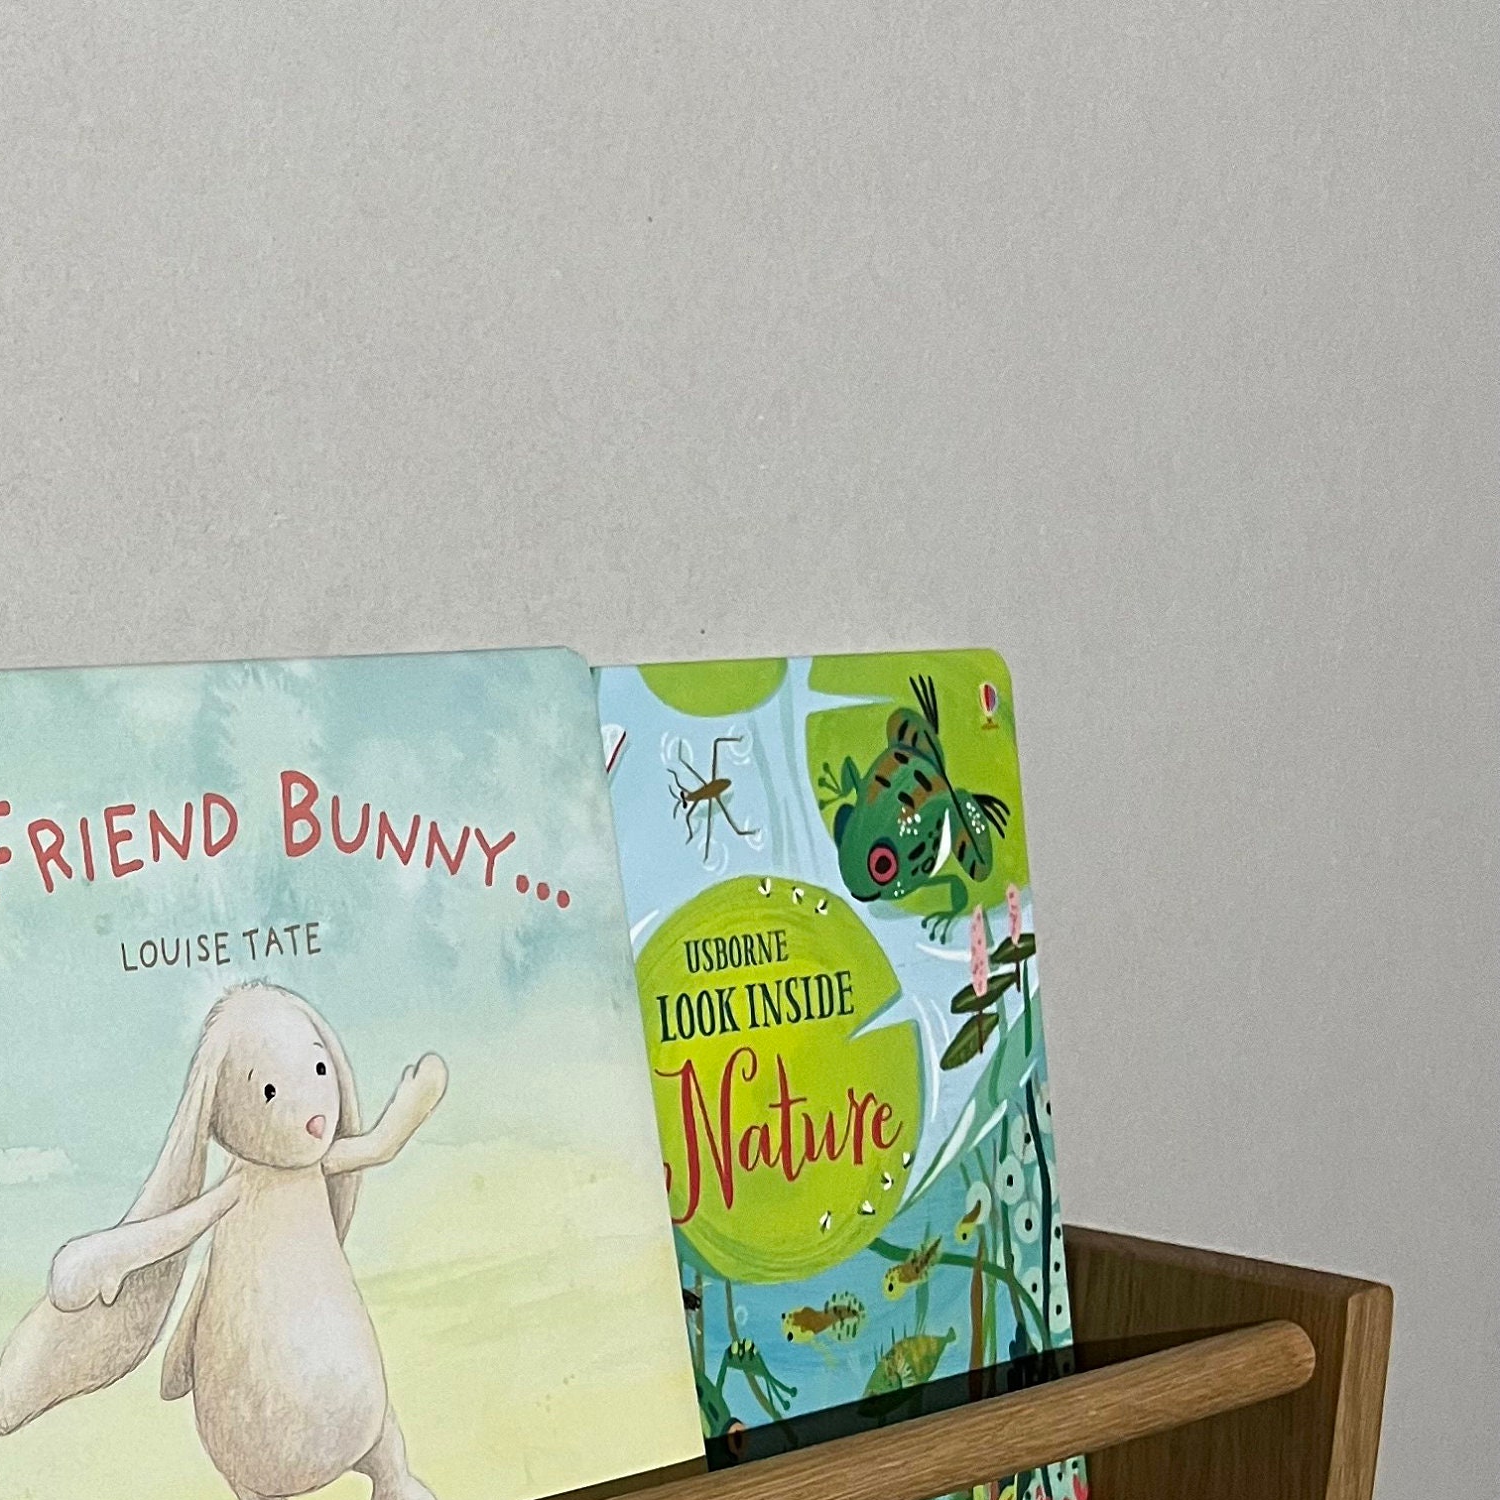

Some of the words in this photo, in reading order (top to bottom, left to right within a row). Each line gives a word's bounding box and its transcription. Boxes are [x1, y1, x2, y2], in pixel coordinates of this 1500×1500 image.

[280, 770, 571, 909] BUNNY...
[120, 932, 231, 972] LOUISE
[242, 922, 322, 961] TATE
[684, 929, 789, 974] USBORNE
[656, 986, 741, 1043] LOOK
[745, 970, 854, 1029] INSIDE
[655, 1046, 904, 1224] Nature
